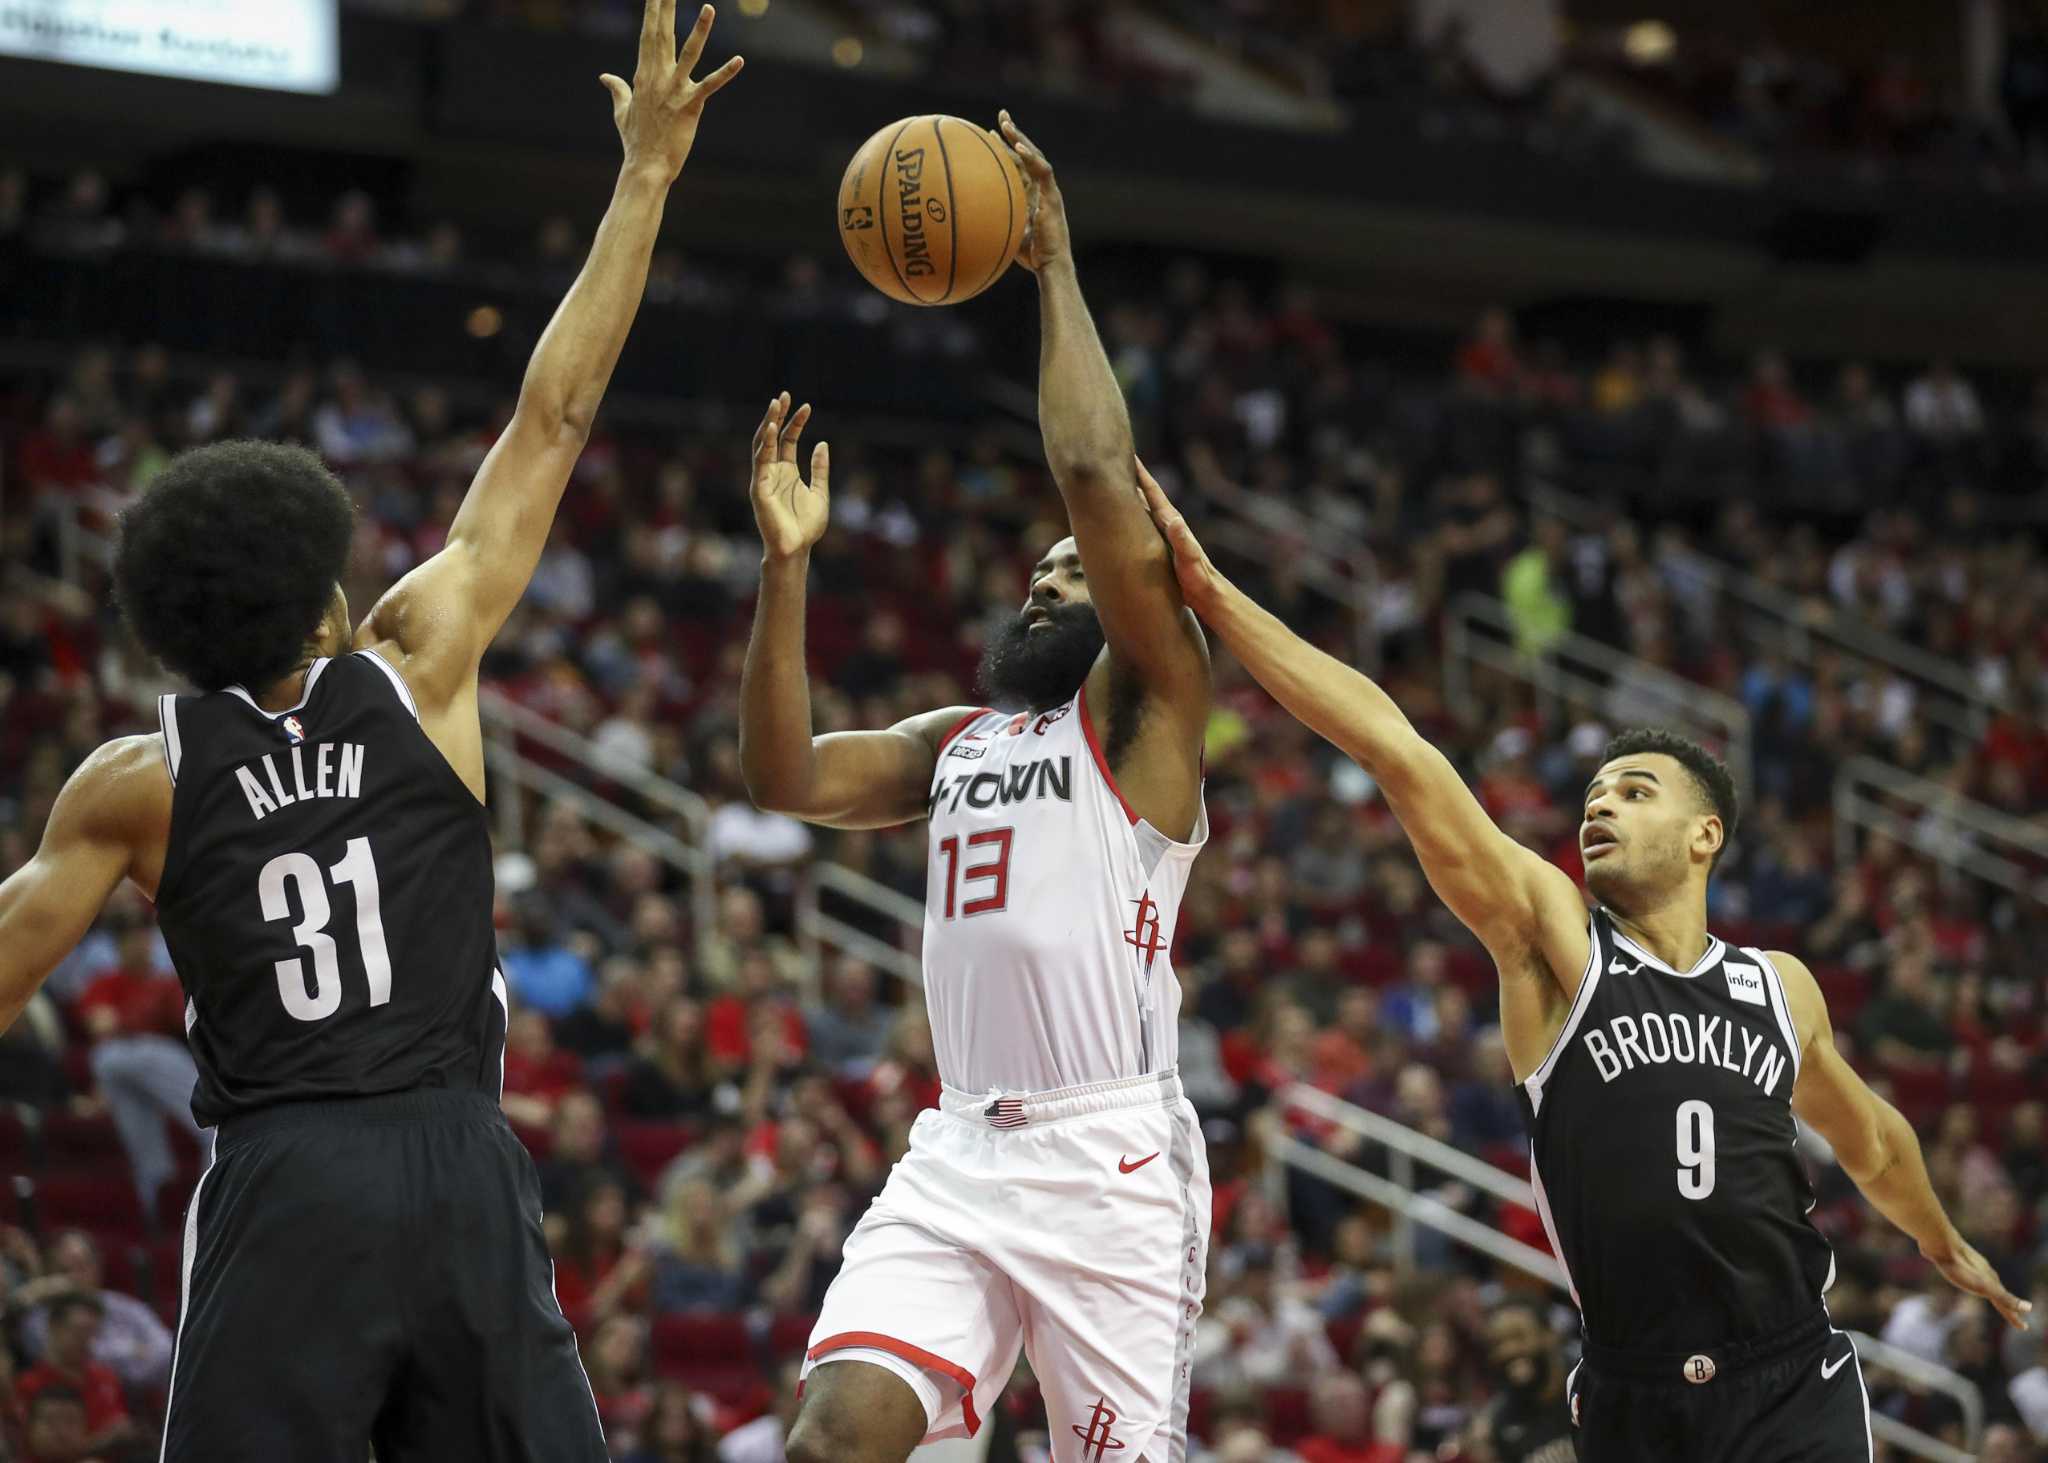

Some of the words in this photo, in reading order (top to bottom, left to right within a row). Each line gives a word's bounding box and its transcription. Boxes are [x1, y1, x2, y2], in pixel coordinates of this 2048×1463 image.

[896, 148, 935, 278] SPALDING
[235, 743, 365, 820] ALLEN
[940, 825, 1015, 922] 13
[258, 836, 392, 1021] 31
[1728, 973, 1759, 989] infor
[1584, 1012, 1786, 1097] BROOKLYN
[1676, 1100, 1716, 1200] 9
[1694, 1359, 1707, 1380] B
